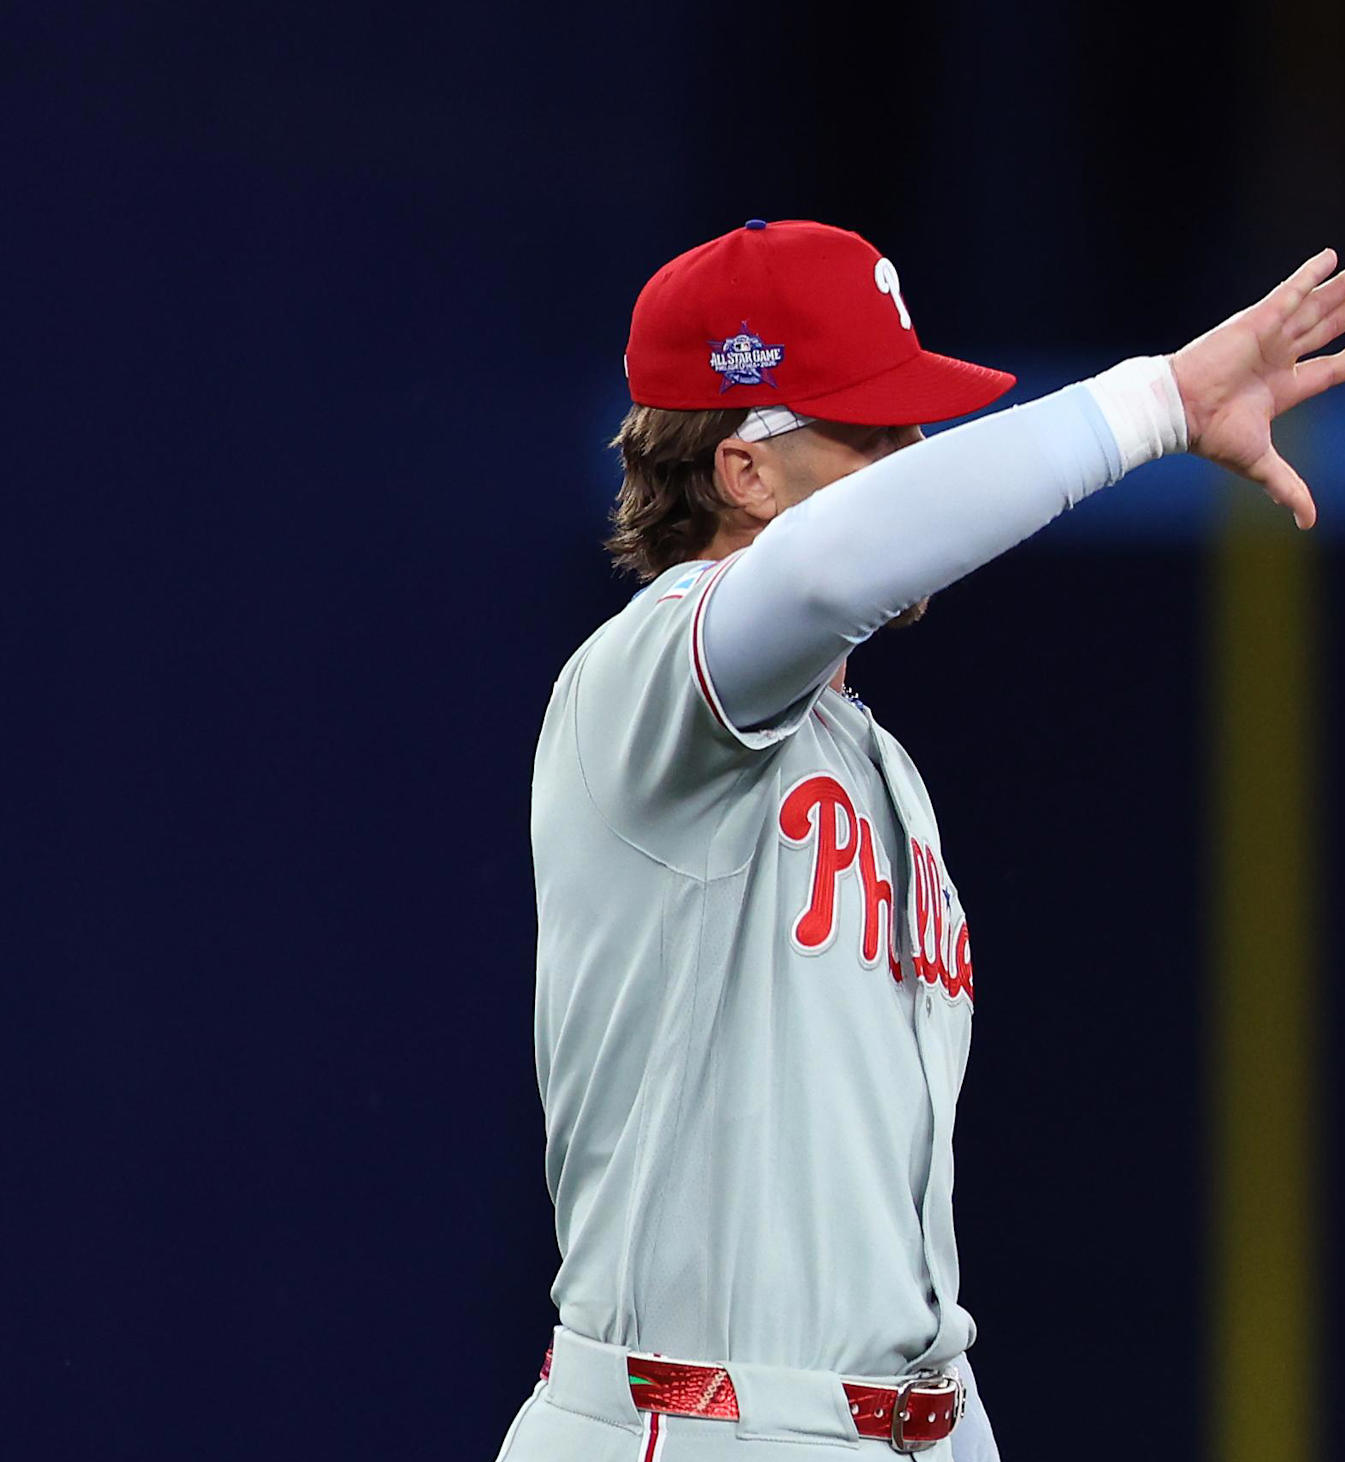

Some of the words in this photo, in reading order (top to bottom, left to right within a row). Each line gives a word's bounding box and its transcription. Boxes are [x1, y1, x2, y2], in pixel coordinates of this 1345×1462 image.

[710, 352, 728, 367] ALL
[727, 350, 752, 365] STAR
[752, 348, 781, 362] GAME
